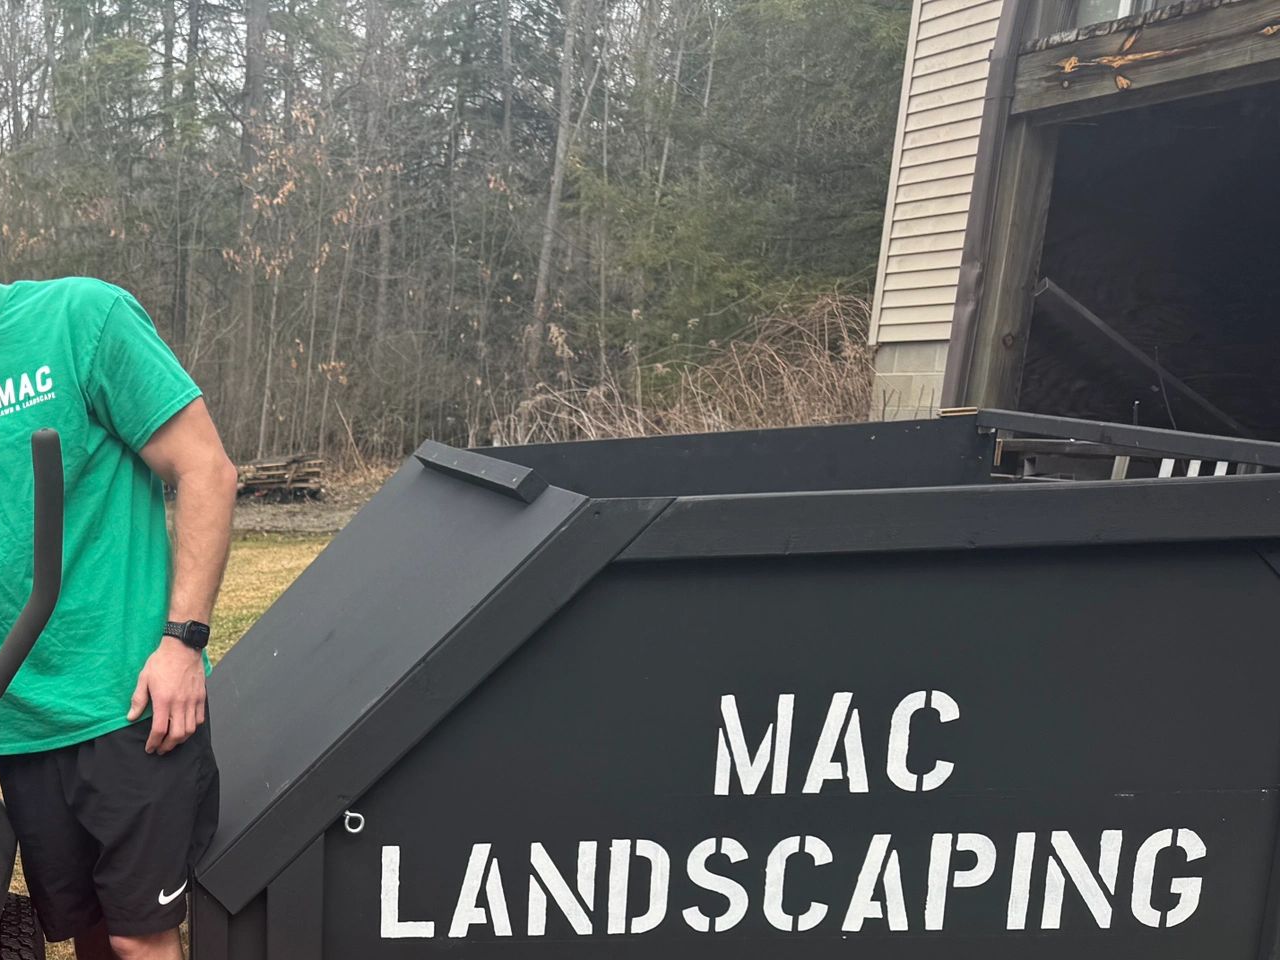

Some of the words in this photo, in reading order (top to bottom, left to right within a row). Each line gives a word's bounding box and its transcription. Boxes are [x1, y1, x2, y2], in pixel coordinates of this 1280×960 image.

[22, 392, 56, 408] LANDSCAPE
[713, 690, 960, 796] MAC
[380, 828, 1208, 938] LANDSCAPING
